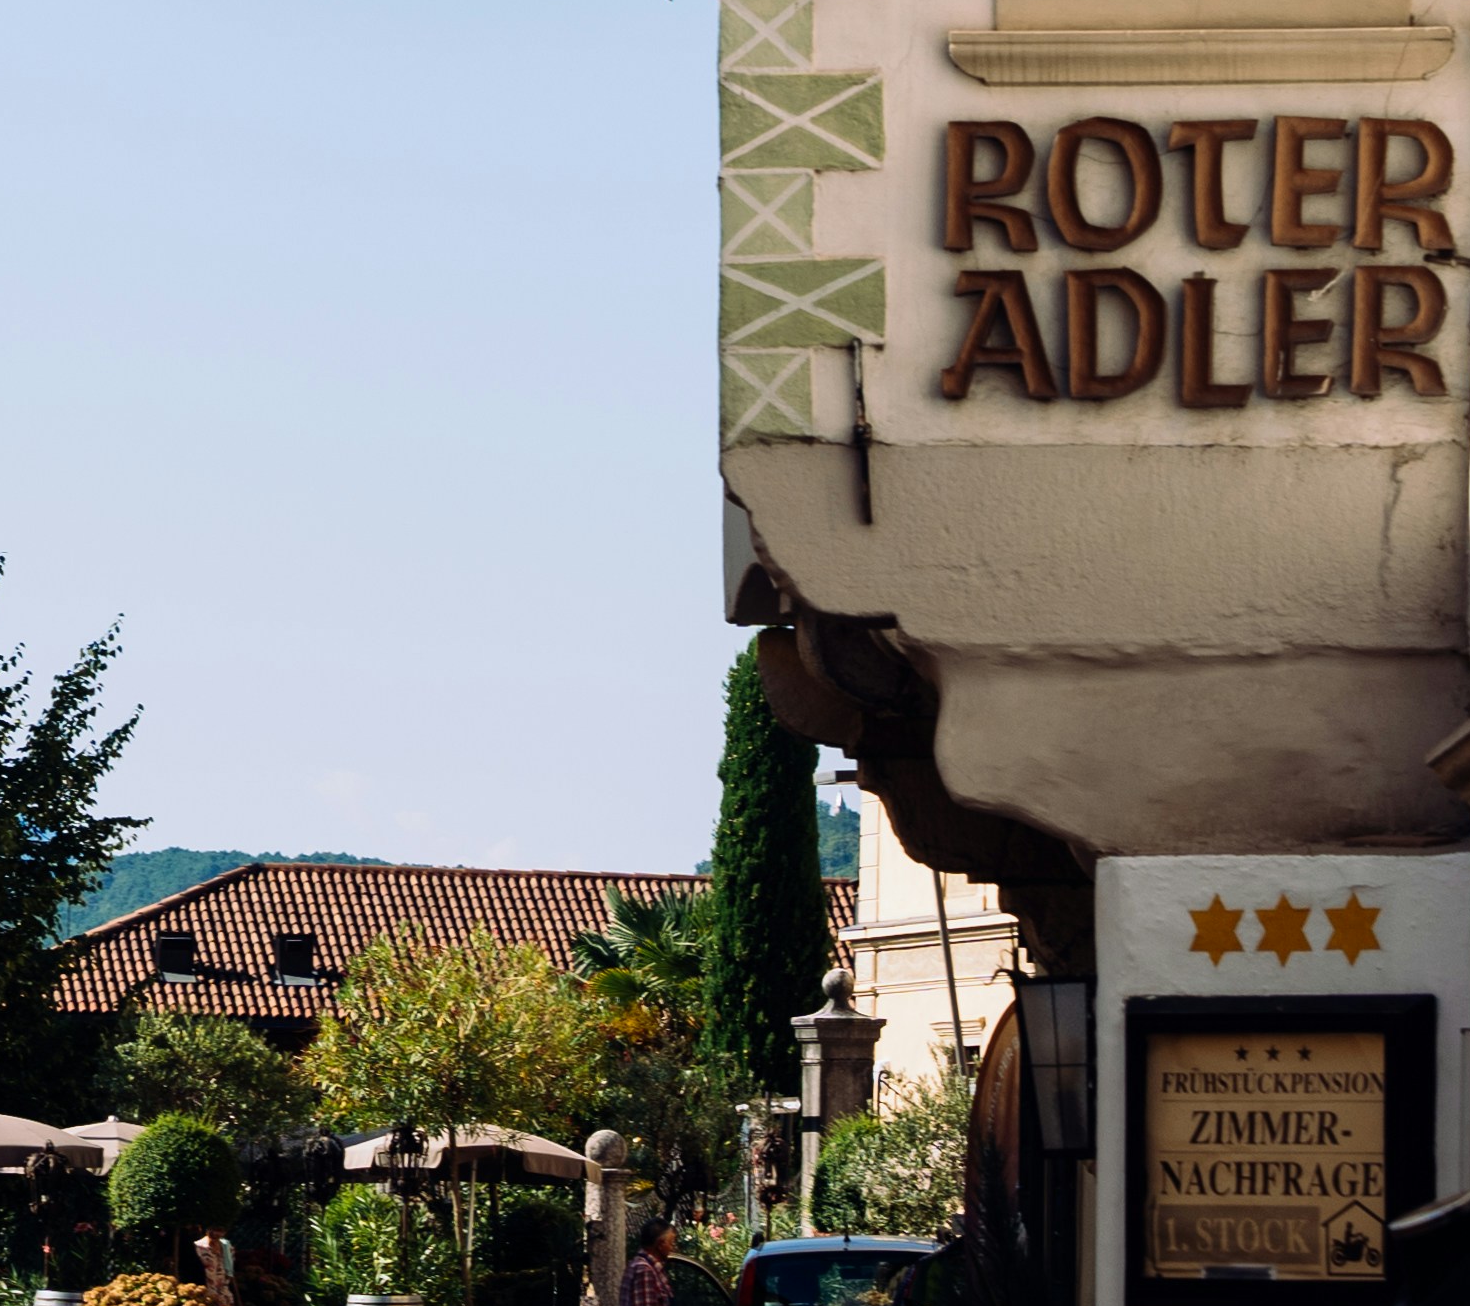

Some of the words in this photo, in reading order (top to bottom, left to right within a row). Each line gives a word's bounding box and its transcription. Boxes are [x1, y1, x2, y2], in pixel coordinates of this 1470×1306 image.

[943, 115, 1455, 252] ROTER
[940, 266, 1451, 407] ADLER
[1161, 1067, 1384, 1095] FRÜHSTÜCKPENSION
[1189, 1110, 1352, 1145] ZIMMER-
[1160, 1160, 1384, 1197] NACHFRAGE
[1164, 1218, 1188, 1252] 1.
[1195, 1215, 1310, 1254] STOCK
